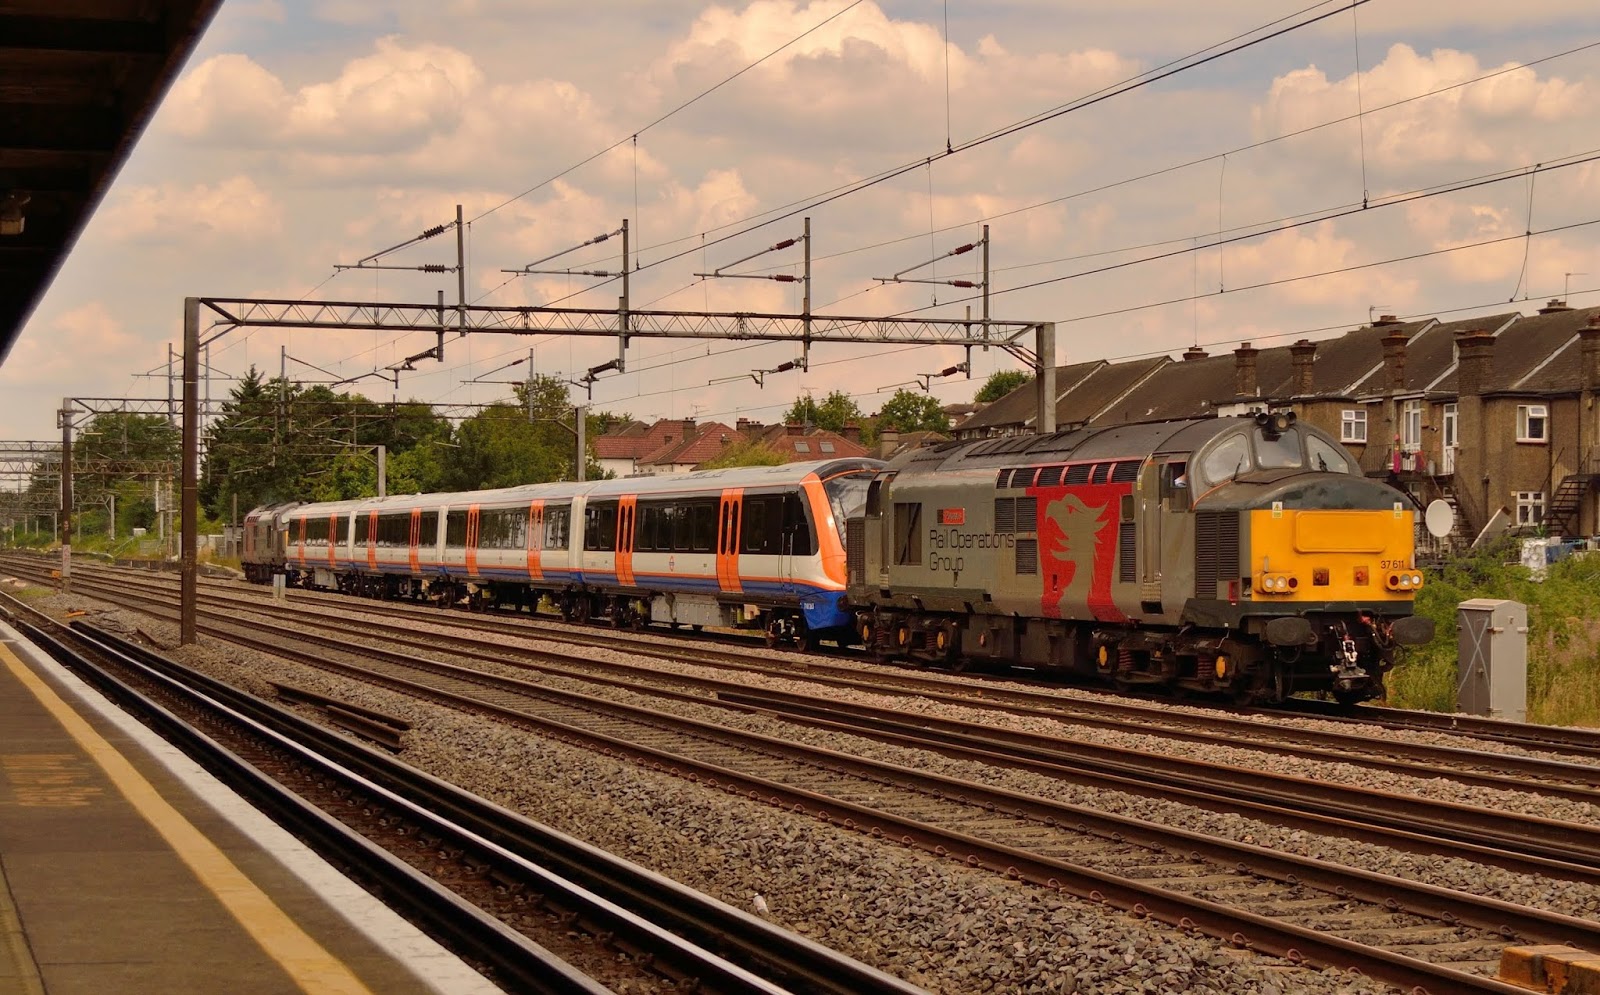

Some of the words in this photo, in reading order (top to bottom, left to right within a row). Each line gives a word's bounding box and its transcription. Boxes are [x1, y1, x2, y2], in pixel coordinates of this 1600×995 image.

[929, 529, 949, 549] Rail
[950, 529, 1015, 552] Operations
[929, 552, 964, 574] Group
